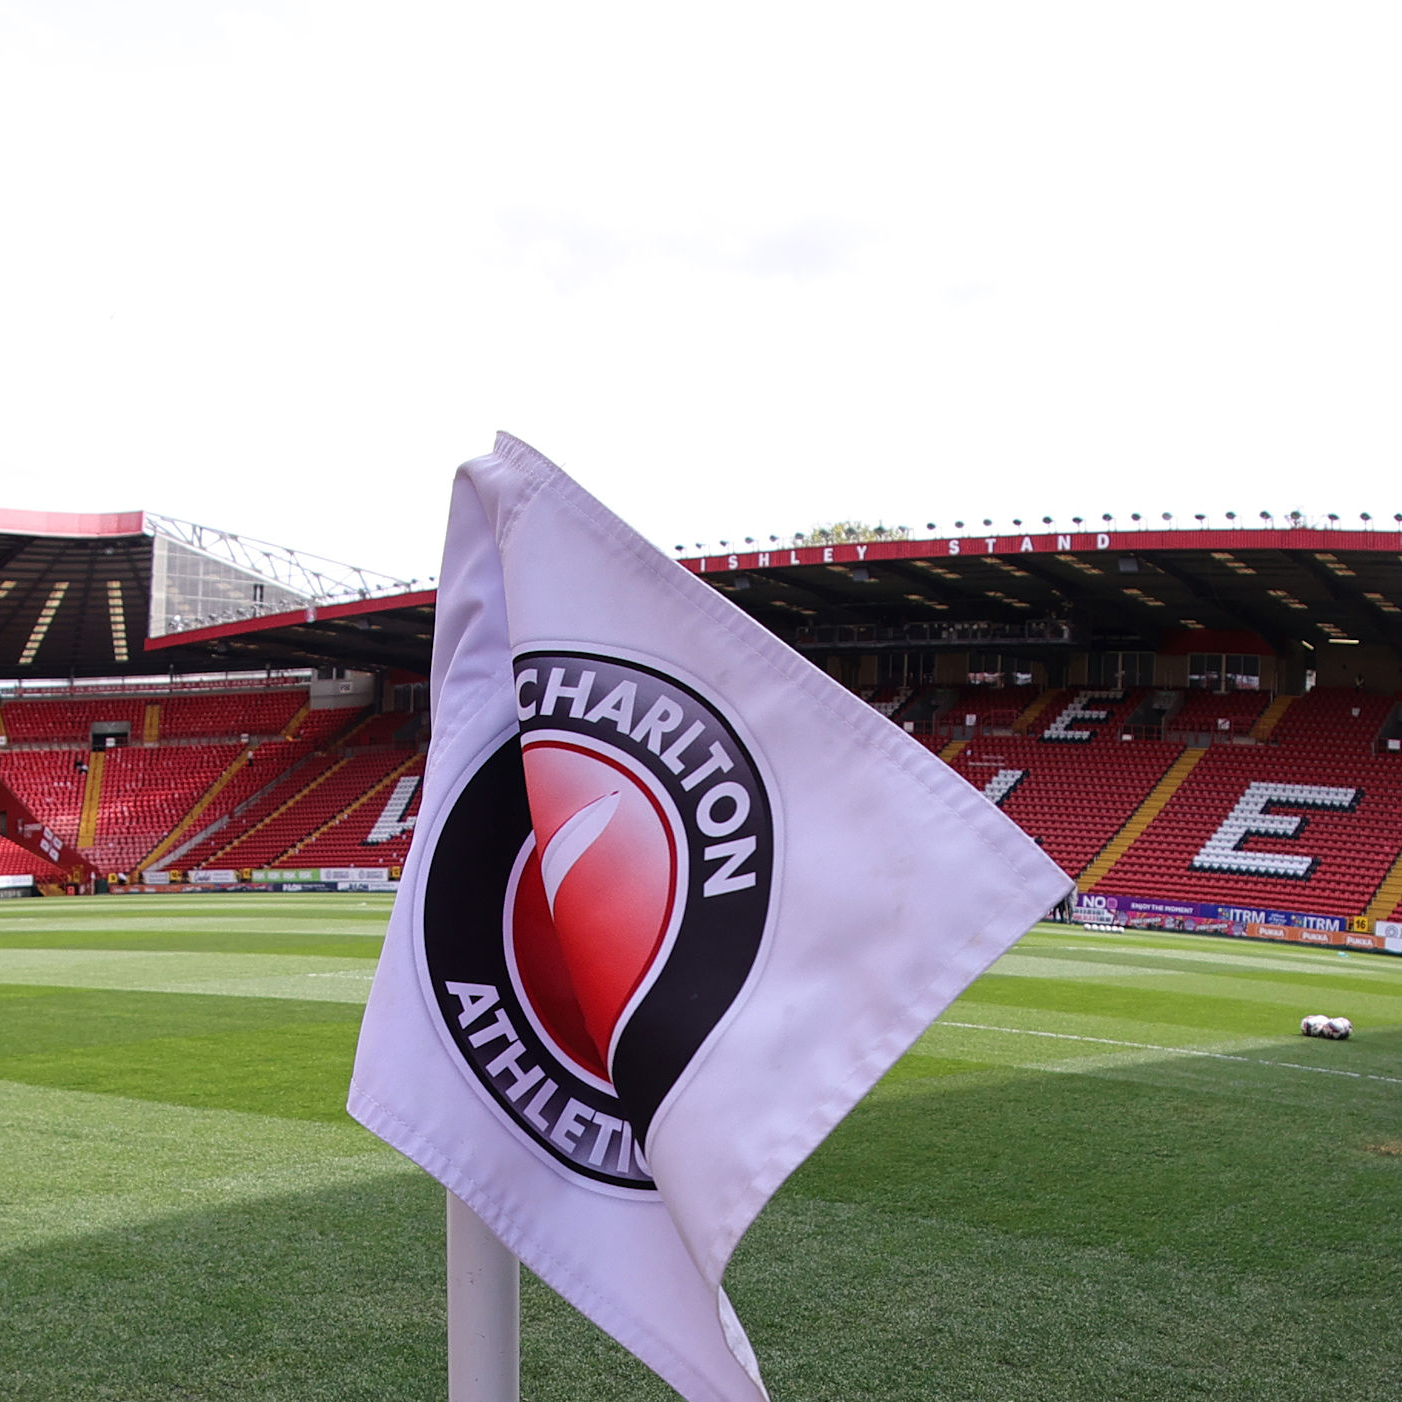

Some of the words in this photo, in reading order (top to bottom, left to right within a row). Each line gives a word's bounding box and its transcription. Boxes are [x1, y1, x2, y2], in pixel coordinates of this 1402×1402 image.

[700, 544, 867, 573] ISHLEY
[948, 532, 1110, 557] STAND
[513, 667, 758, 899] CHARLTON
[1130, 901, 1151, 911] ENJOY
[1151, 903, 1165, 912] THE
[1165, 904, 1194, 914] MOMENT
[1229, 908, 1266, 924] ITRM
[1303, 916, 1341, 932] ITRM
[1355, 917, 1366, 929] 16
